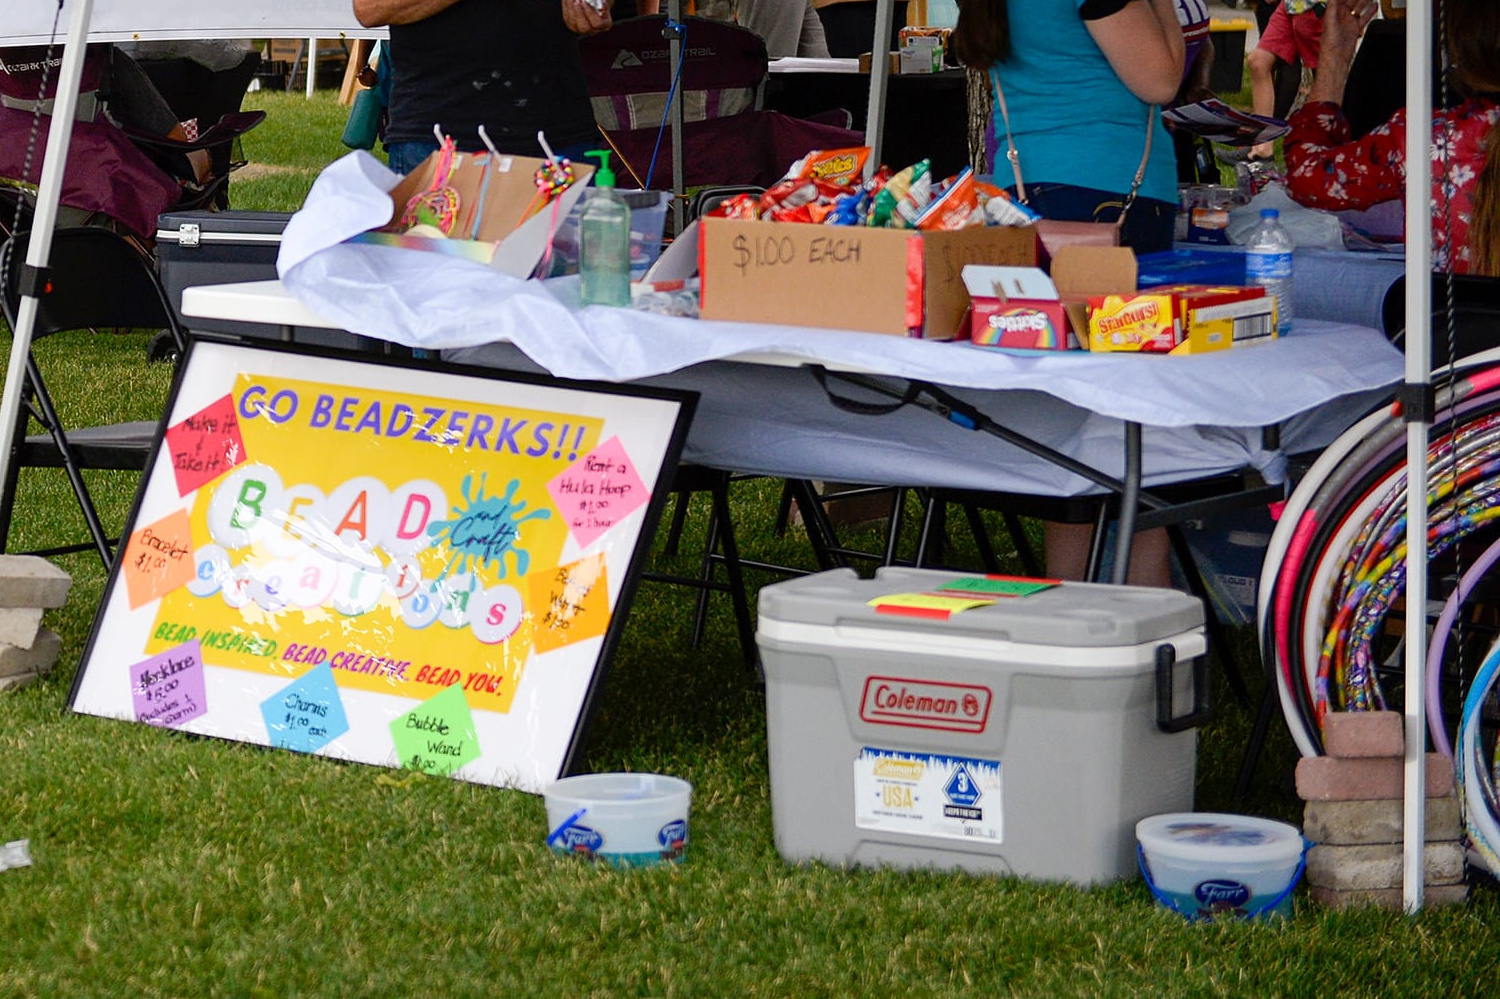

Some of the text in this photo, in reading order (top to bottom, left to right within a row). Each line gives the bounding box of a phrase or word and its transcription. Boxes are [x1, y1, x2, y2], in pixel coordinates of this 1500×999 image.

[732, 234, 861, 278] $1.00 EACH
[238, 386, 587, 462] GO BEADZERKS!!
[617, 464, 627, 475] a
[560, 478, 631, 498] Hula Hoop
[230, 479, 431, 542] BEAD
[474, 504, 507, 522] and
[140, 528, 189, 562] Bracelet
[154, 621, 198, 642] BEAD
[282, 643, 328, 665] BEAD
[415, 664, 462, 687] BEAD
[463, 671, 503, 696] YOU.
[285, 693, 329, 718] Charms
[874, 684, 958, 715] Coleman
[405, 713, 449, 736] Bubble
[427, 740, 464, 757] Wand
[957, 772, 969, 793] 3
[882, 785, 913, 809] USA
[1200, 882, 1245, 907] Farr
